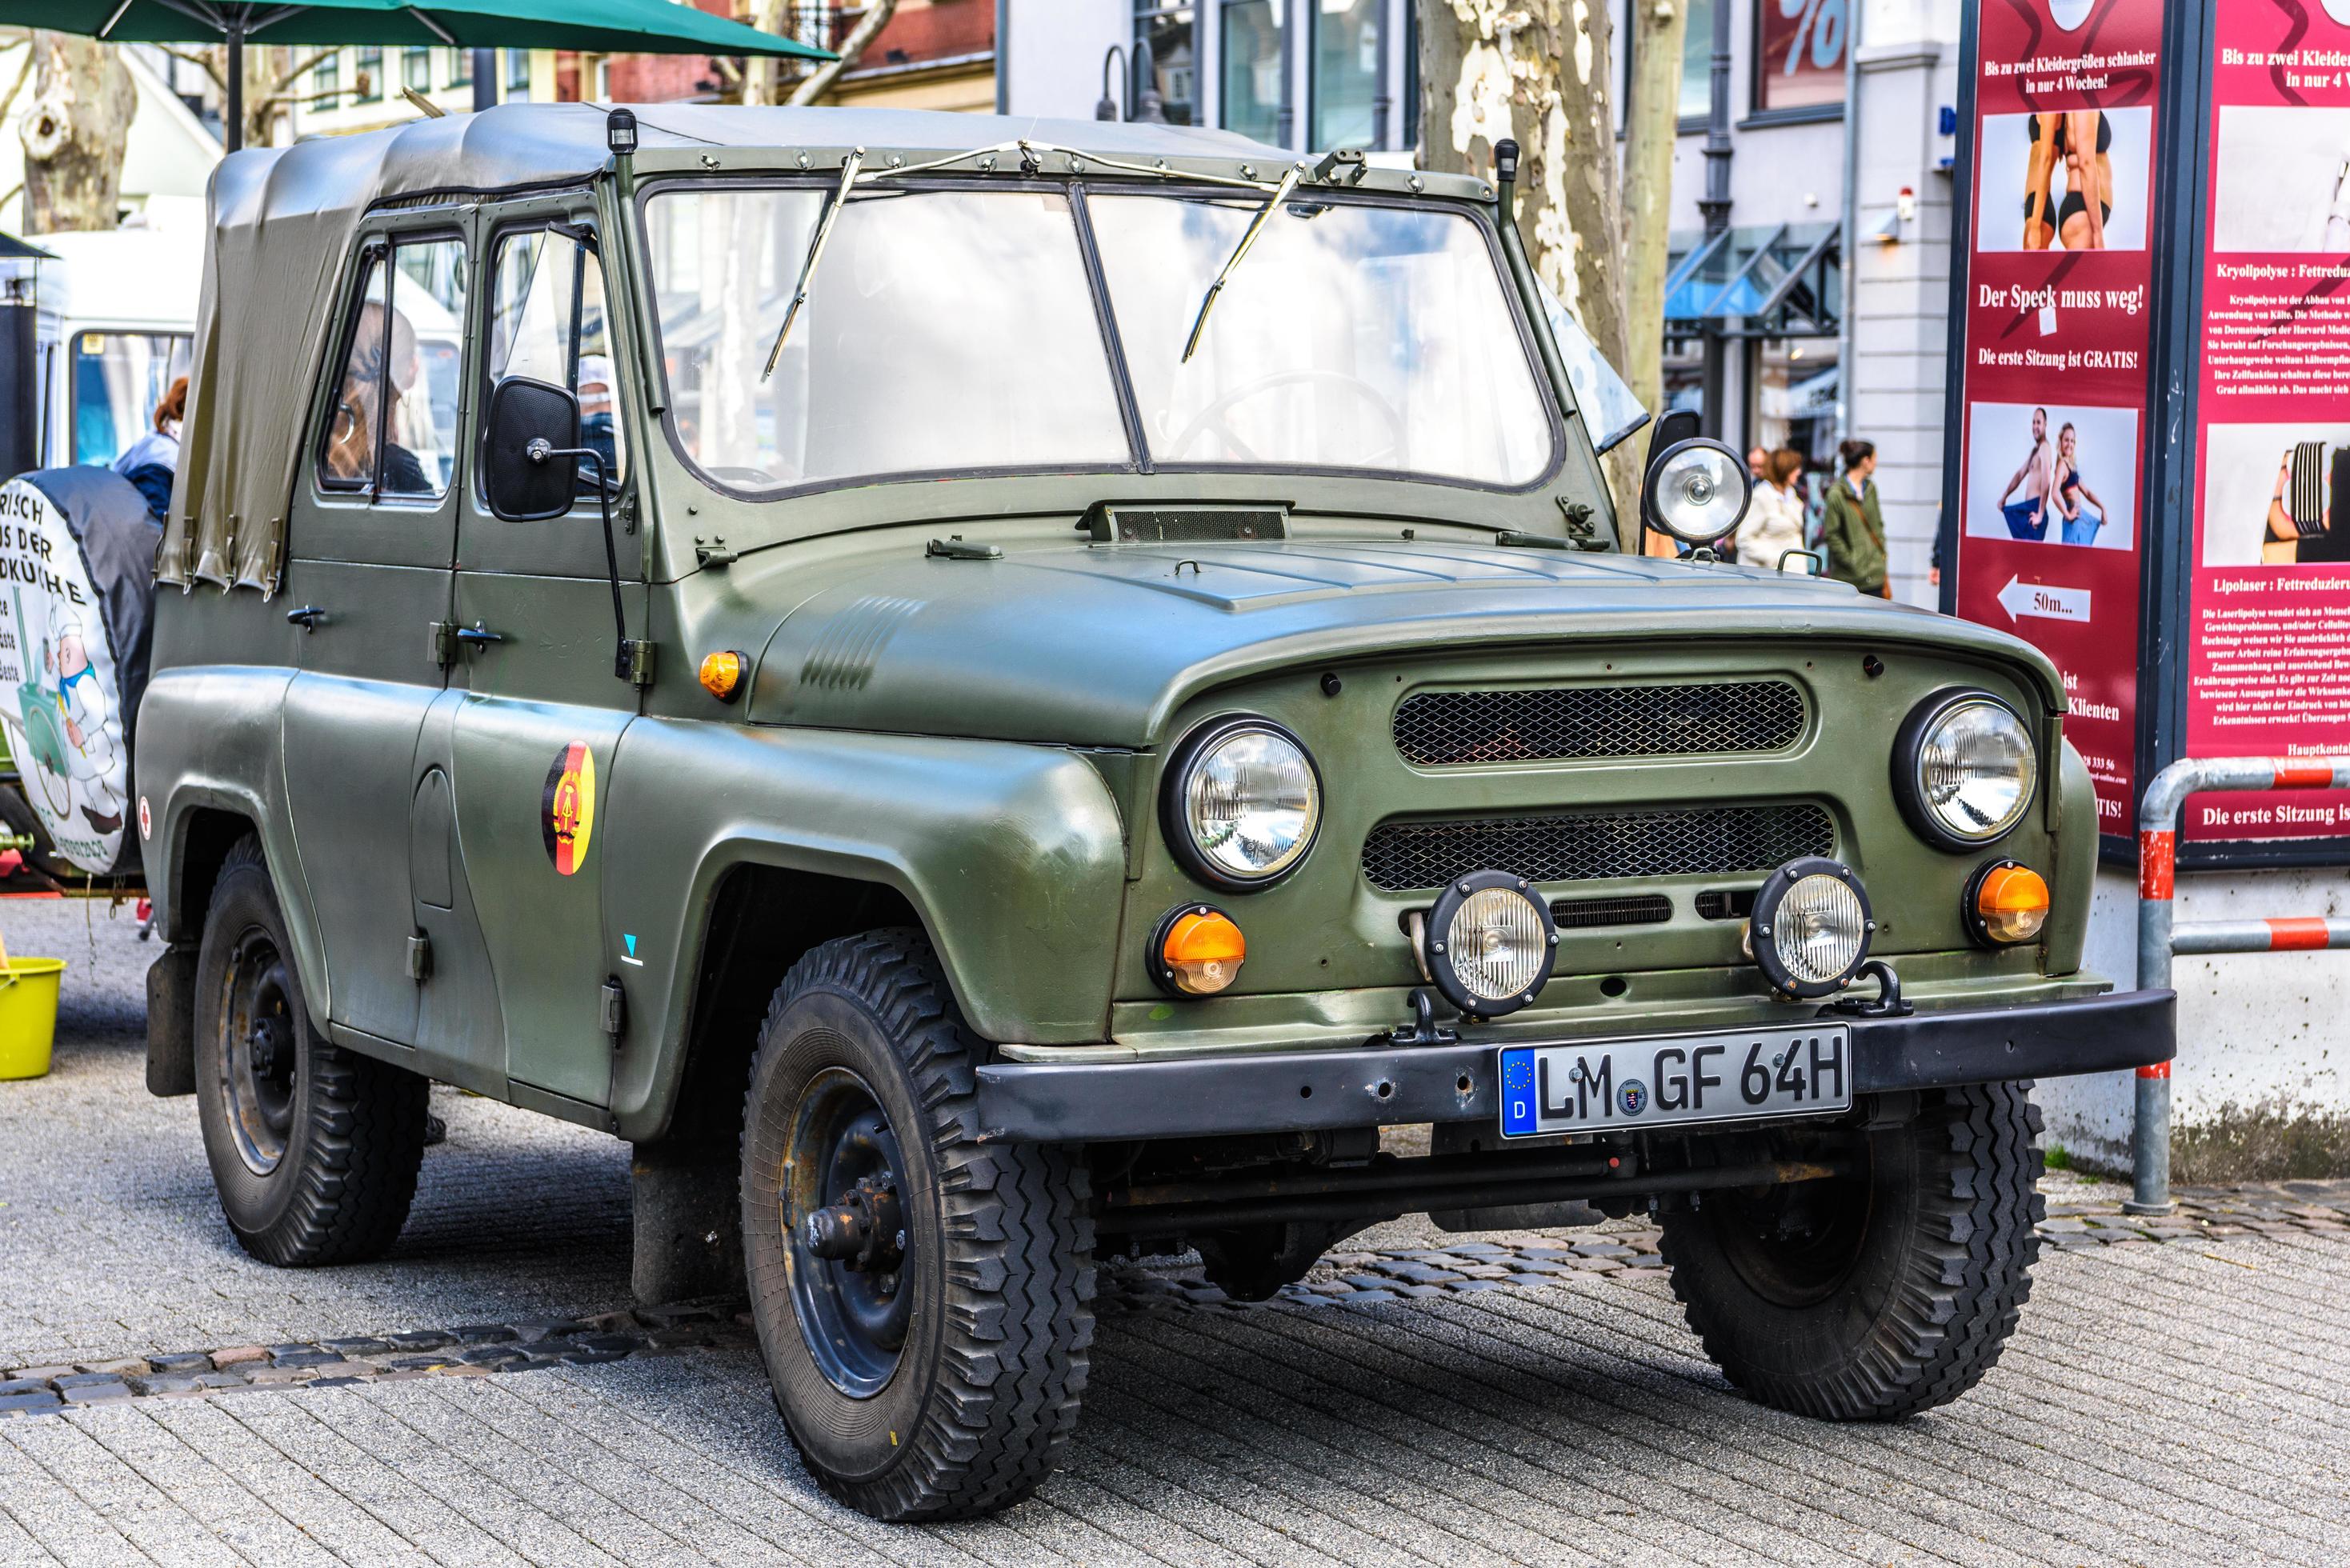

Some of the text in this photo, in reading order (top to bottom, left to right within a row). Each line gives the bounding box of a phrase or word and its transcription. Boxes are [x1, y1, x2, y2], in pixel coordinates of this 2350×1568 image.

[1984, 50, 2156, 76] Bis zu zwei Kleidergrößen schlanker
[2222, 48, 2244, 65] Bis
[2247, 53, 2264, 65] zu
[2267, 50, 2298, 66] zwei
[2026, 74, 2108, 94] in nur 4 Wochen!
[2286, 71, 2300, 87] in
[2304, 75, 2329, 87] nur
[2332, 72, 2341, 87] 4
[2216, 264, 2288, 280] Kryolipolyse
[1979, 284, 2143, 315] Der Speck muss weg!
[2279, 295, 2288, 305] ist
[2289, 295, 2303, 305] der
[2331, 297, 2345, 305] von
[2208, 310, 2253, 322] Anwendung
[2255, 312, 2268, 320] von
[2294, 310, 2308, 320] Die
[2309, 310, 2342, 320] Methode
[2208, 326, 2223, 334] von
[2224, 325, 2277, 336] Dermatologen
[2279, 325, 2292, 334] der
[2293, 325, 2326, 334] Harvard
[2208, 340, 2220, 350] Sie
[2248, 340, 2261, 350] auf
[1978, 347, 2138, 371] Die erste Sitzung ist GRATIS!
[2214, 370, 2231, 379] Ihre
[2232, 370, 2279, 379] Zellfunktion
[2280, 370, 2311, 379] schalten
[2312, 370, 2331, 379] diese
[2216, 385, 2236, 394] Grad
[2238, 385, 2277, 394] allmählich
[2292, 385, 2308, 394] Das
[2308, 385, 2332, 394] macht
[2334, 385, 2349, 394] sich
[18, 528, 52, 562] DER
[2213, 578, 2267, 595] Lipolaser
[2034, 592, 2072, 614] 50m...
[2202, 609, 2216, 618] Die
[2268, 607, 2294, 618] wendet
[2296, 607, 2311, 617] sich
[2312, 609, 2322, 617] an
[2269, 634, 2283, 644] wir
[2284, 634, 2296, 644] Sie
[2237, 648, 2261, 658] Arbeit
[2212, 662, 2272, 672] Zusammenhang
[2273, 661, 2286, 670] mit
[2064, 670, 2078, 690] ist
[2280, 674, 2288, 683] Es
[2291, 674, 2305, 685] gibt
[2307, 674, 2320, 682] zur
[2321, 673, 2336, 682] Zeit
[2240, 689, 2274, 699] Aussagen
[2276, 687, 2294, 697] über
[2295, 687, 2307, 697] die
[2068, 697, 2120, 721] Klienten
[2216, 702, 2234, 712] wird
[2236, 702, 2251, 711] hier
[2252, 702, 2272, 711] nicht
[2273, 702, 2286, 710] der
[2324, 701, 2337, 709] von
[2092, 757, 2104, 769] 333
[2106, 758, 2115, 770] 56
[2203, 808, 2230, 826] Die
[2233, 808, 2272, 824] erste
[2276, 805, 2335, 826] Sitzung
[1538, 1054, 1612, 1119] LM
[1654, 1045, 1725, 1110] GF
[1740, 1035, 1844, 1105] 64H
[1514, 1101, 1525, 1119] D
